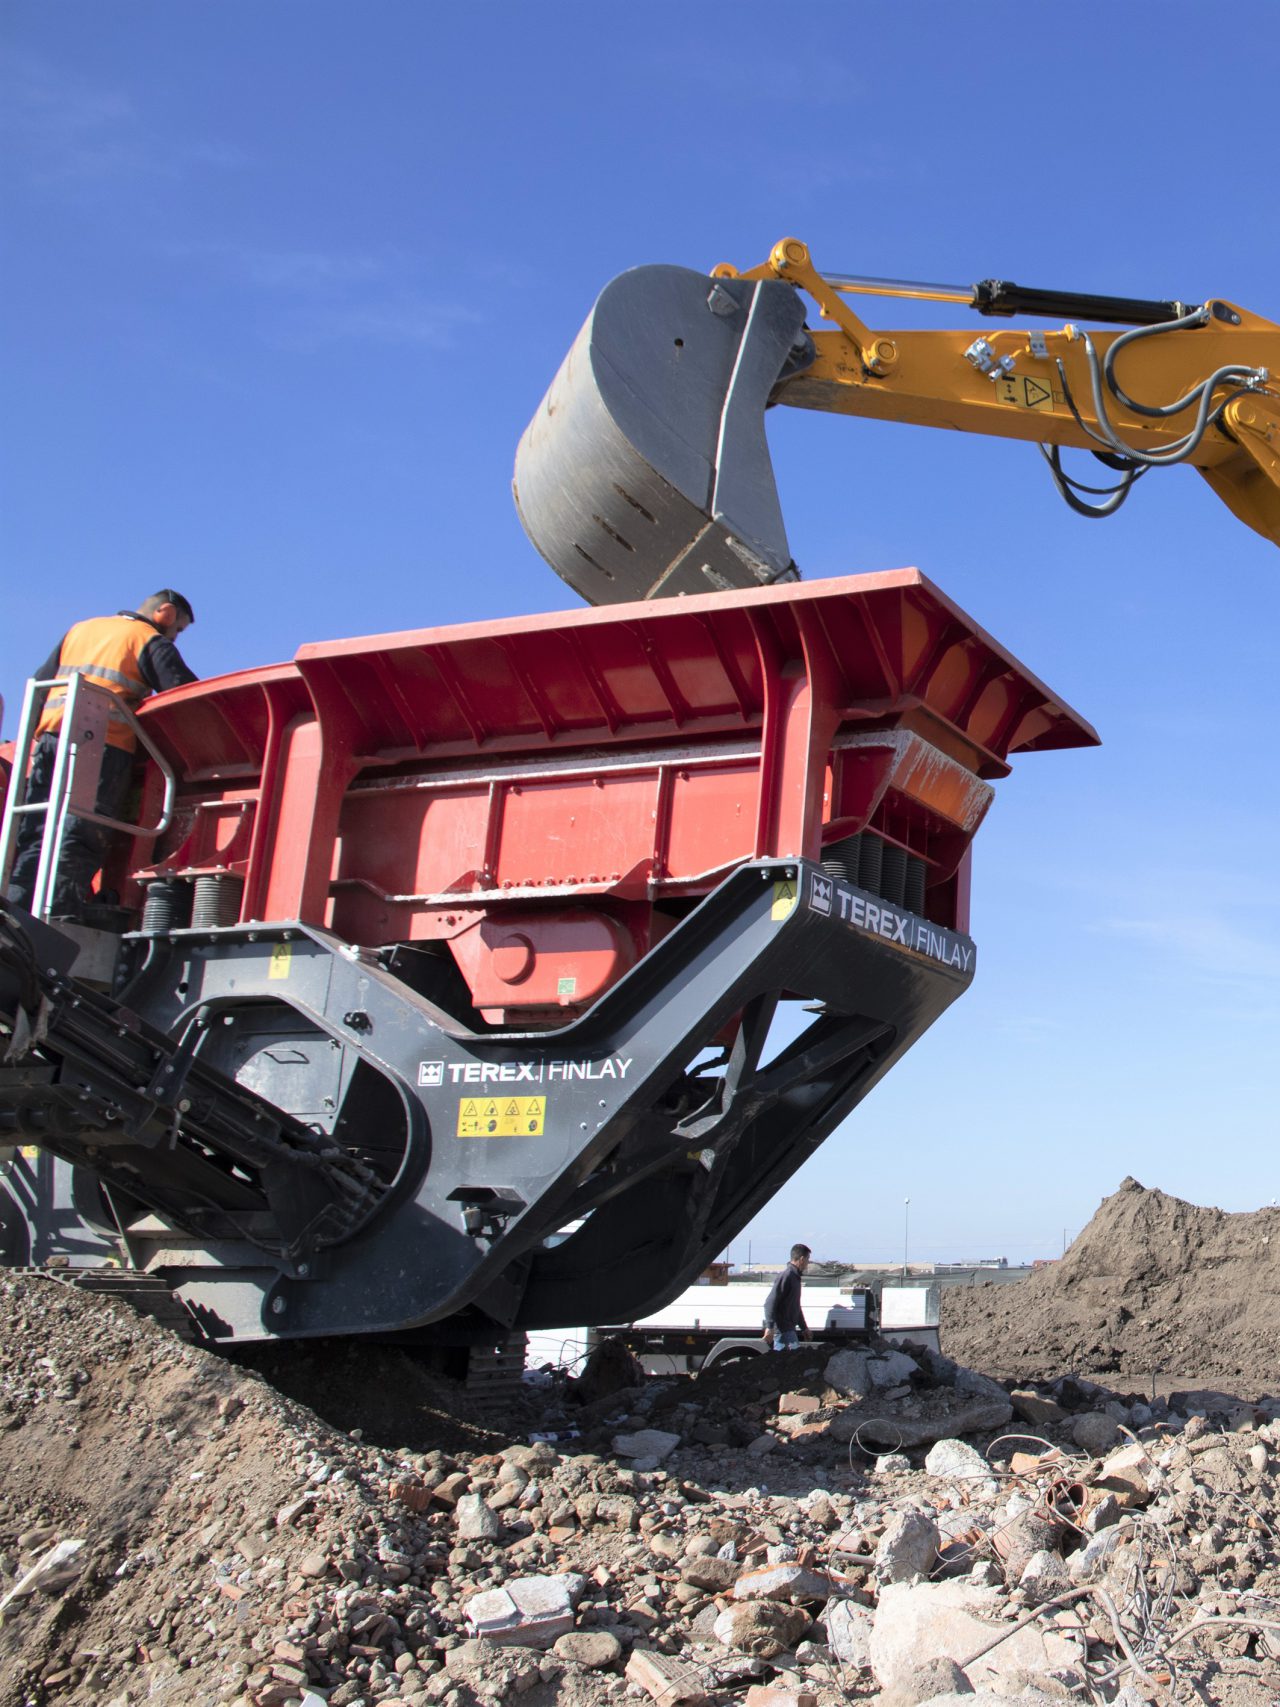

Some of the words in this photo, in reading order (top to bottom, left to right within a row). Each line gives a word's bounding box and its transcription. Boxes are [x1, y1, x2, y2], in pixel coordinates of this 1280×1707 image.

[837, 888, 908, 945] TEREX
[916, 926, 972, 972] FINLAY
[448, 1061, 535, 1083] TEREX
[548, 1058, 633, 1081] FINLAY
